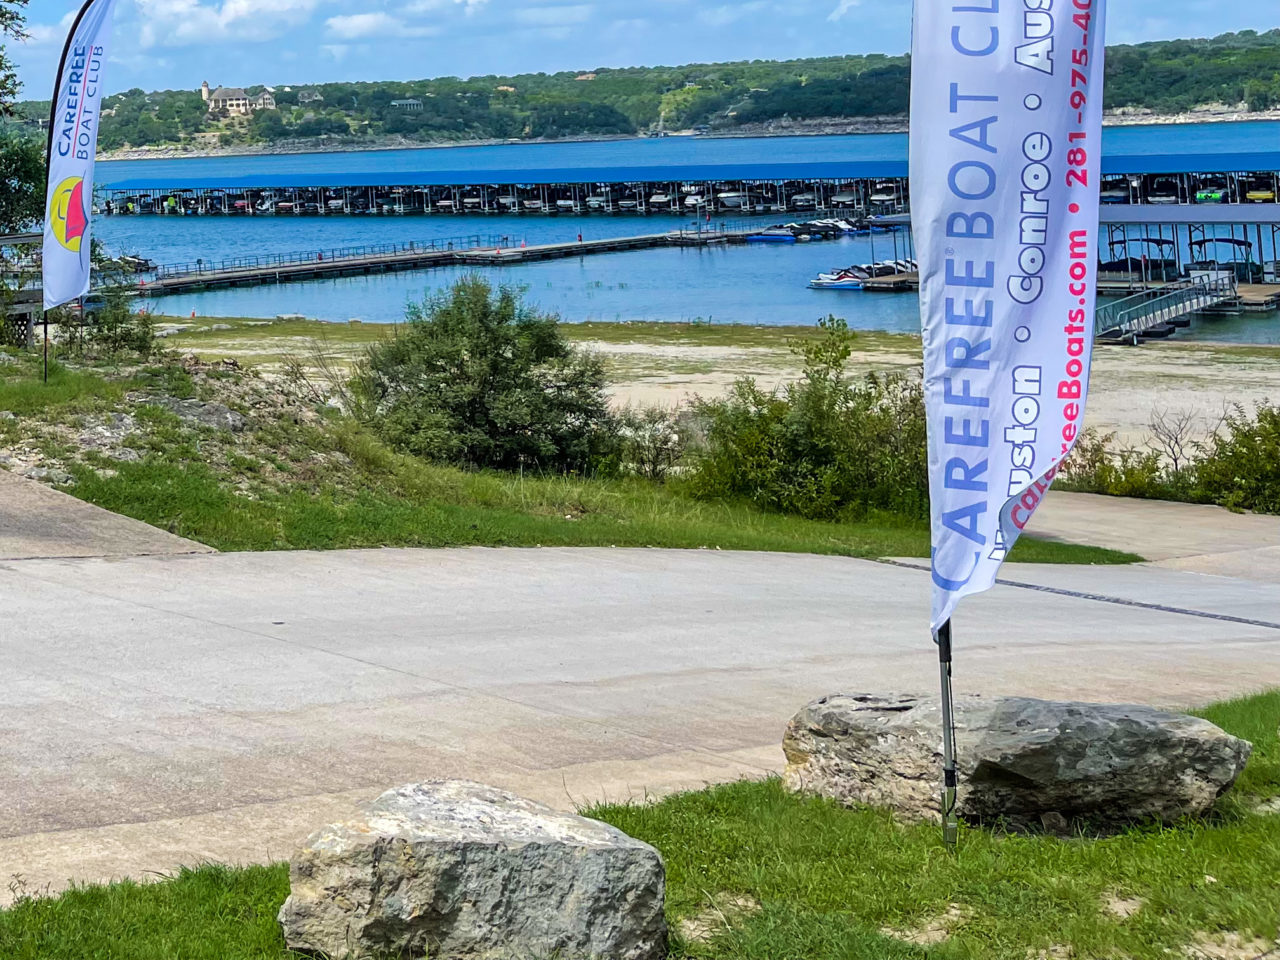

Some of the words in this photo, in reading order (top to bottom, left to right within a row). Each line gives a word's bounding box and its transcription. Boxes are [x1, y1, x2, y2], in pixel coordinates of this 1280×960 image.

[58, 45, 86, 157] CAREFREE
[76, 106, 93, 160] BOAT
[87, 46, 104, 98] CLUB
[946, 83, 999, 240] BOAT
[1007, 132, 1052, 304] Conroe
